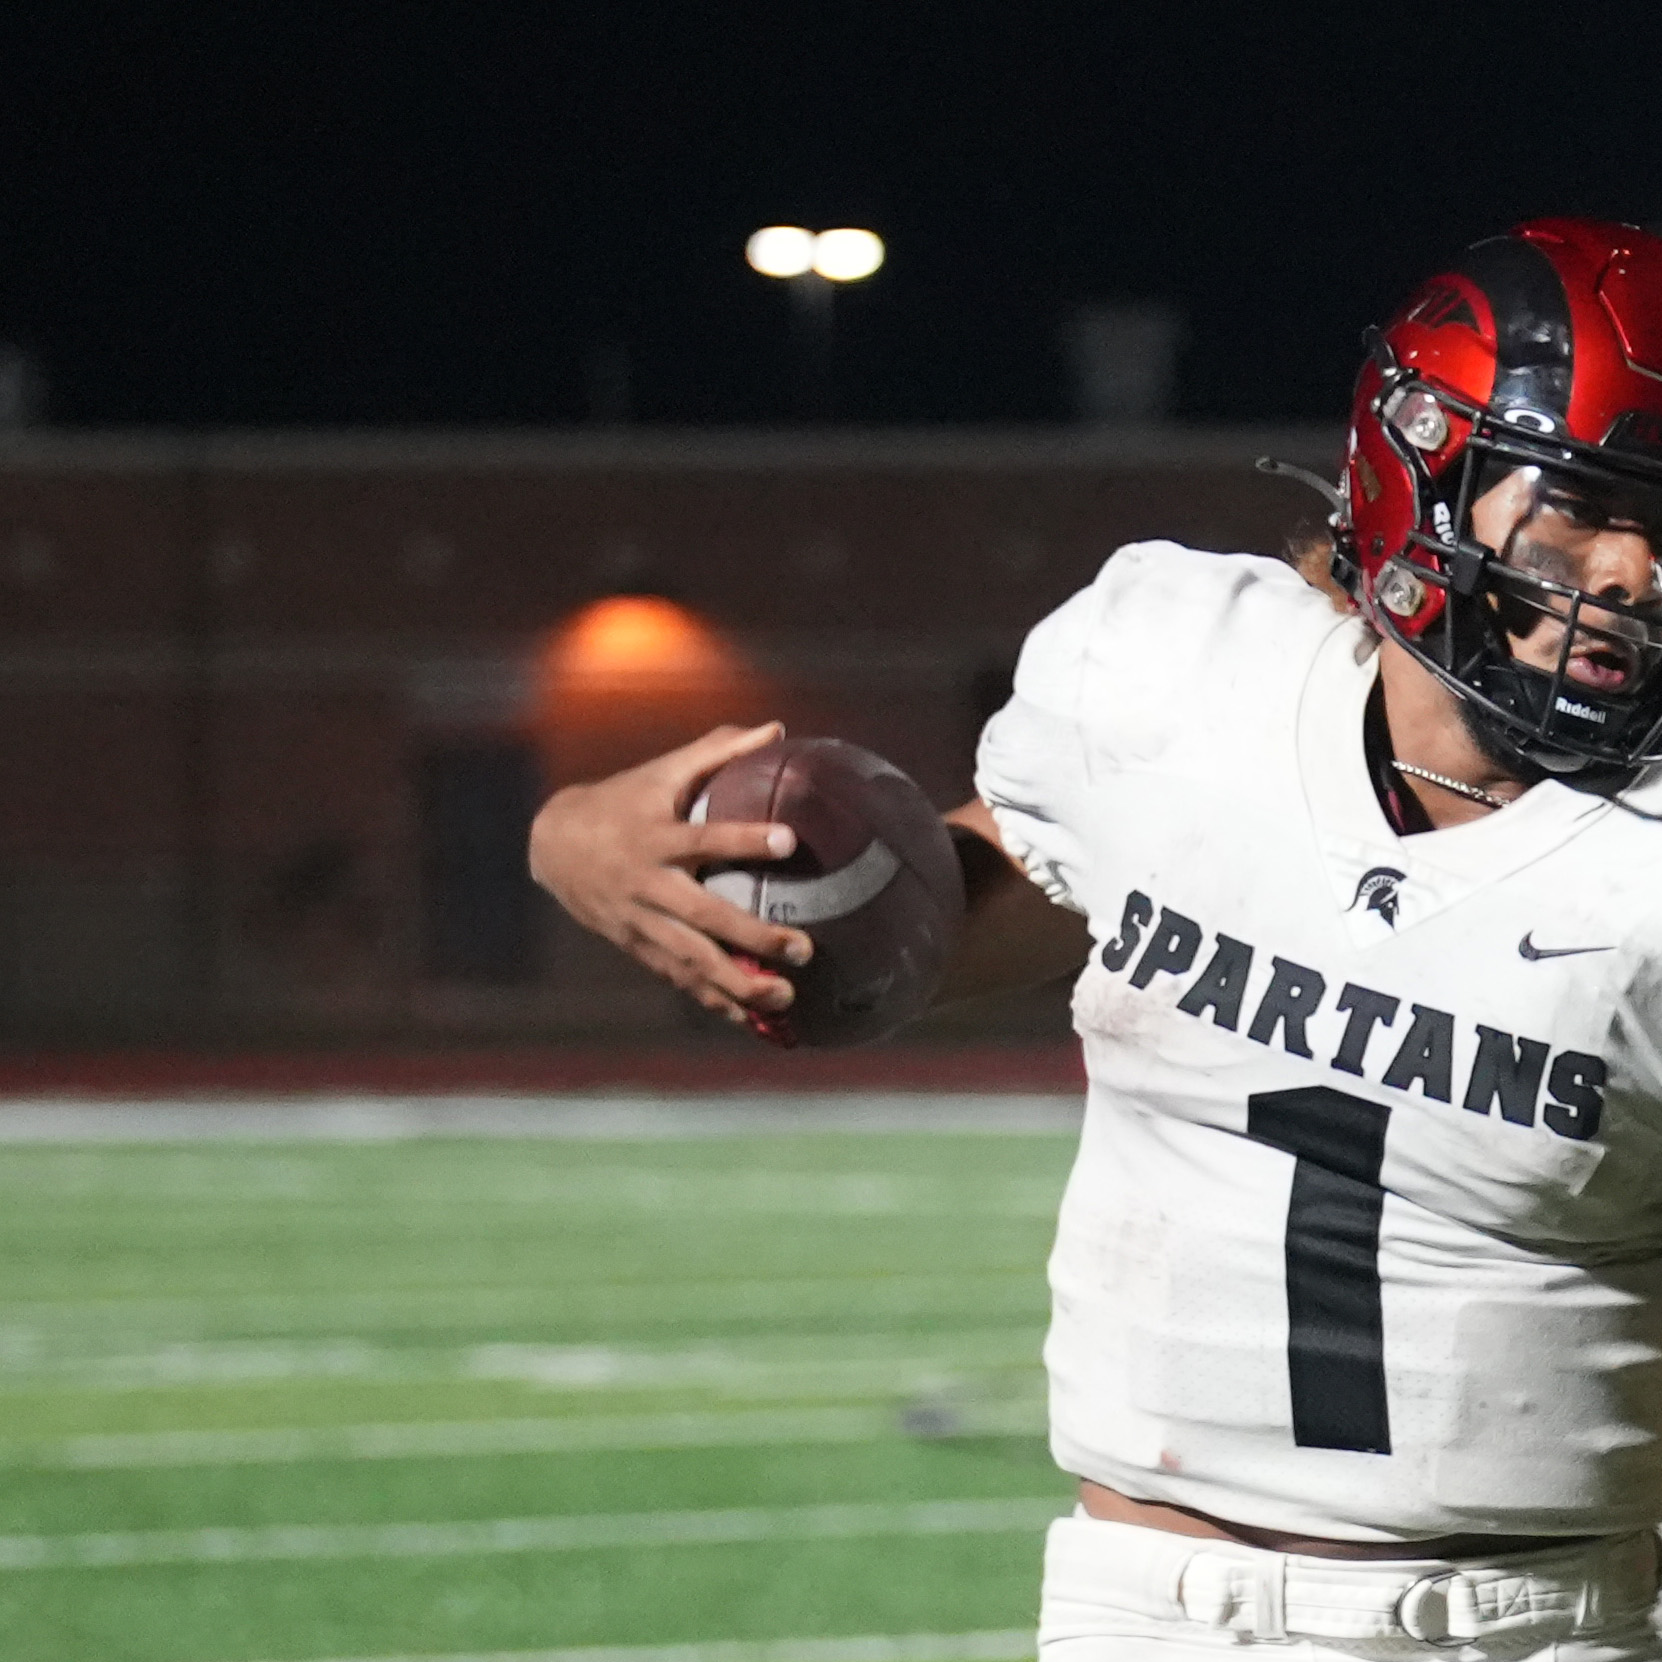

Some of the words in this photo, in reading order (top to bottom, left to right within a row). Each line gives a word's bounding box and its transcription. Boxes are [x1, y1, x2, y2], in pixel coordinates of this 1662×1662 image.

[1555, 697, 1606, 724] Riddell
[1102, 889, 1607, 1142] SPARTANS
[1248, 1086, 1392, 1455] 1
